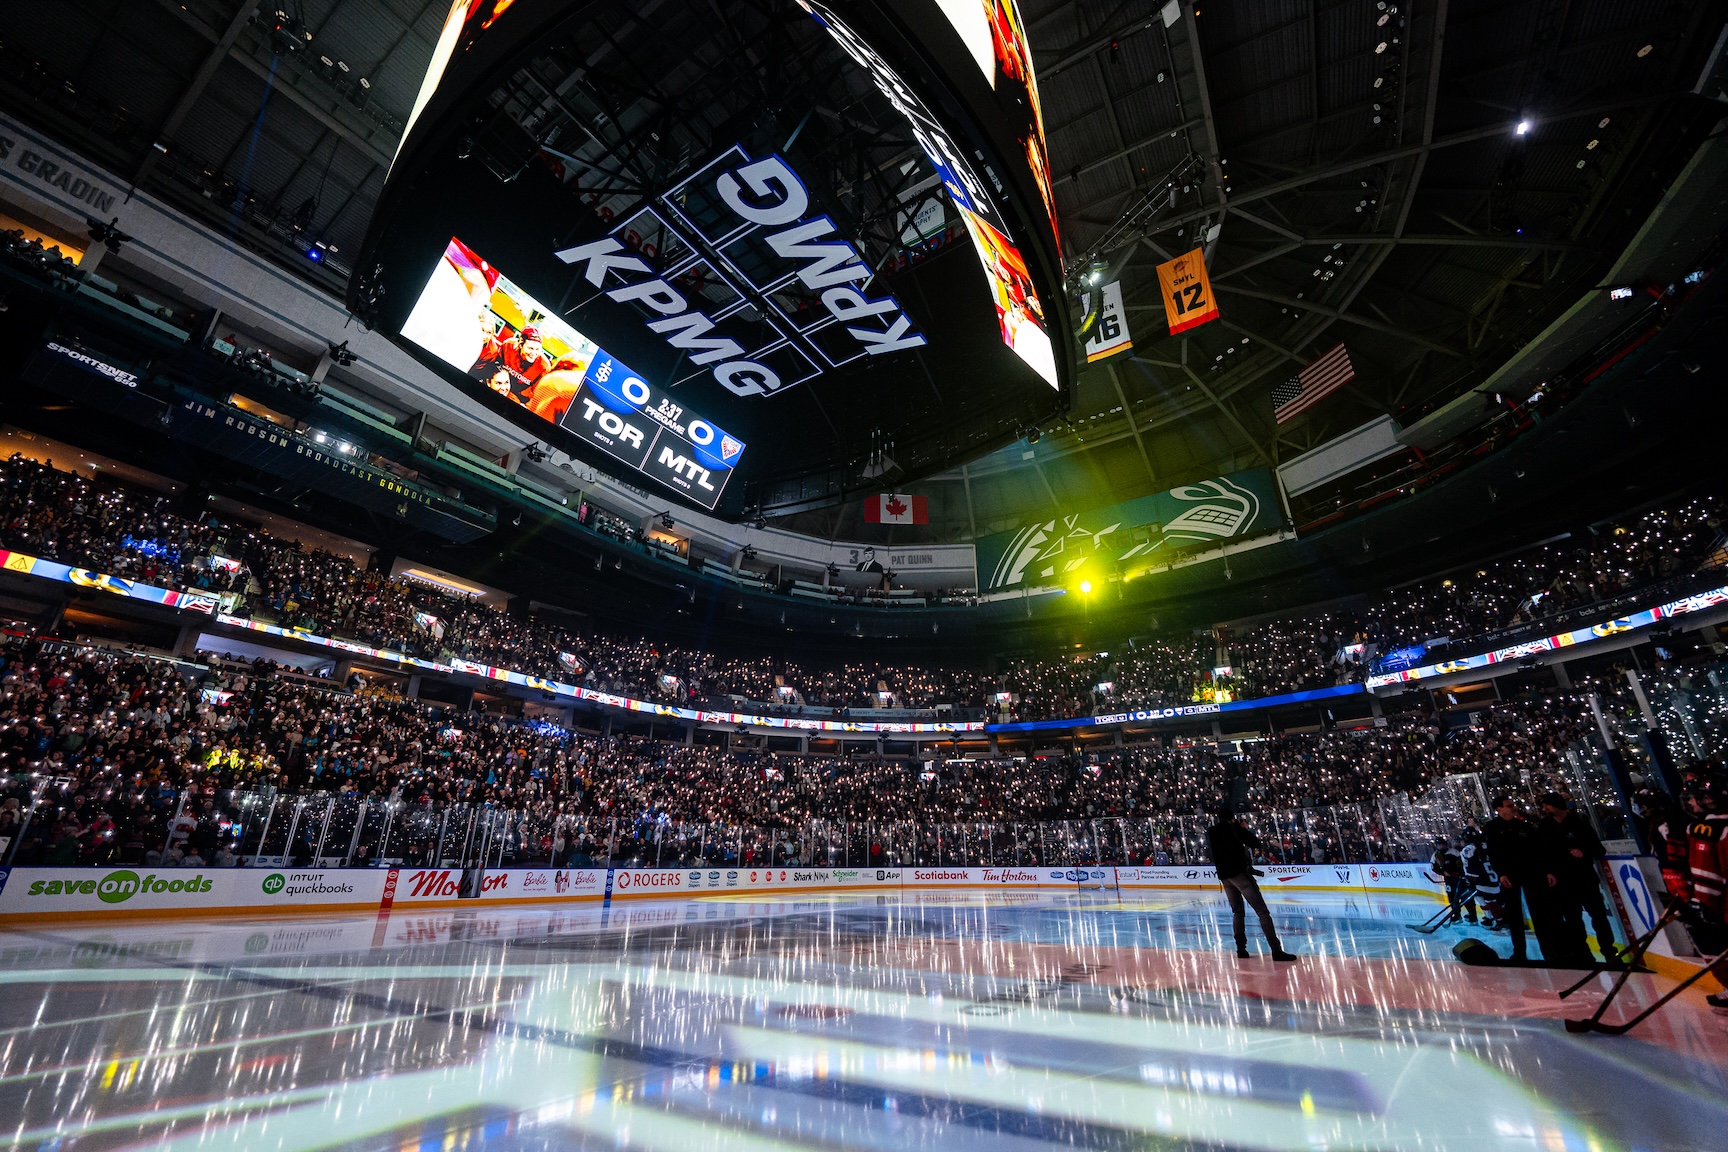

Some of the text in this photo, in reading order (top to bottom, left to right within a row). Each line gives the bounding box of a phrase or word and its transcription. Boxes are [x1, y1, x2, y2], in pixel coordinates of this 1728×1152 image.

[17, 150, 115, 213] GRADIN
[717, 153, 928, 356] KPMG
[1173, 273, 1194, 286] SMYL
[1172, 282, 1206, 315] 12
[554, 237, 782, 398] KPMG
[47, 342, 138, 382] SPORTSNET
[622, 377, 650, 405] 0
[645, 405, 686, 435] PREGAME
[658, 398, 683, 422] 2:37
[583, 397, 645, 449] TOR
[688, 420, 714, 446] 0
[185, 401, 432, 505] JIM ROBSON BROADCAST GONDOLA
[658, 446, 715, 491] MTL
[849, 550, 859, 564] 3
[892, 554, 933, 565] PAT QUINN
[27, 874, 213, 895] save on foods
[290, 874, 324, 882] INTUIT
[408, 870, 508, 897] Moon
[523, 871, 548, 886] Barbie
[575, 871, 597, 885] Barbie
[634, 873, 681, 886] ROGERS
[793, 872, 812, 882] Shark
[914, 870, 968, 880] Scotiabank
[982, 869, 999, 881] Tim
[1001, 869, 1037, 881] Hortons
[286, 883, 353, 897] quickbooks
